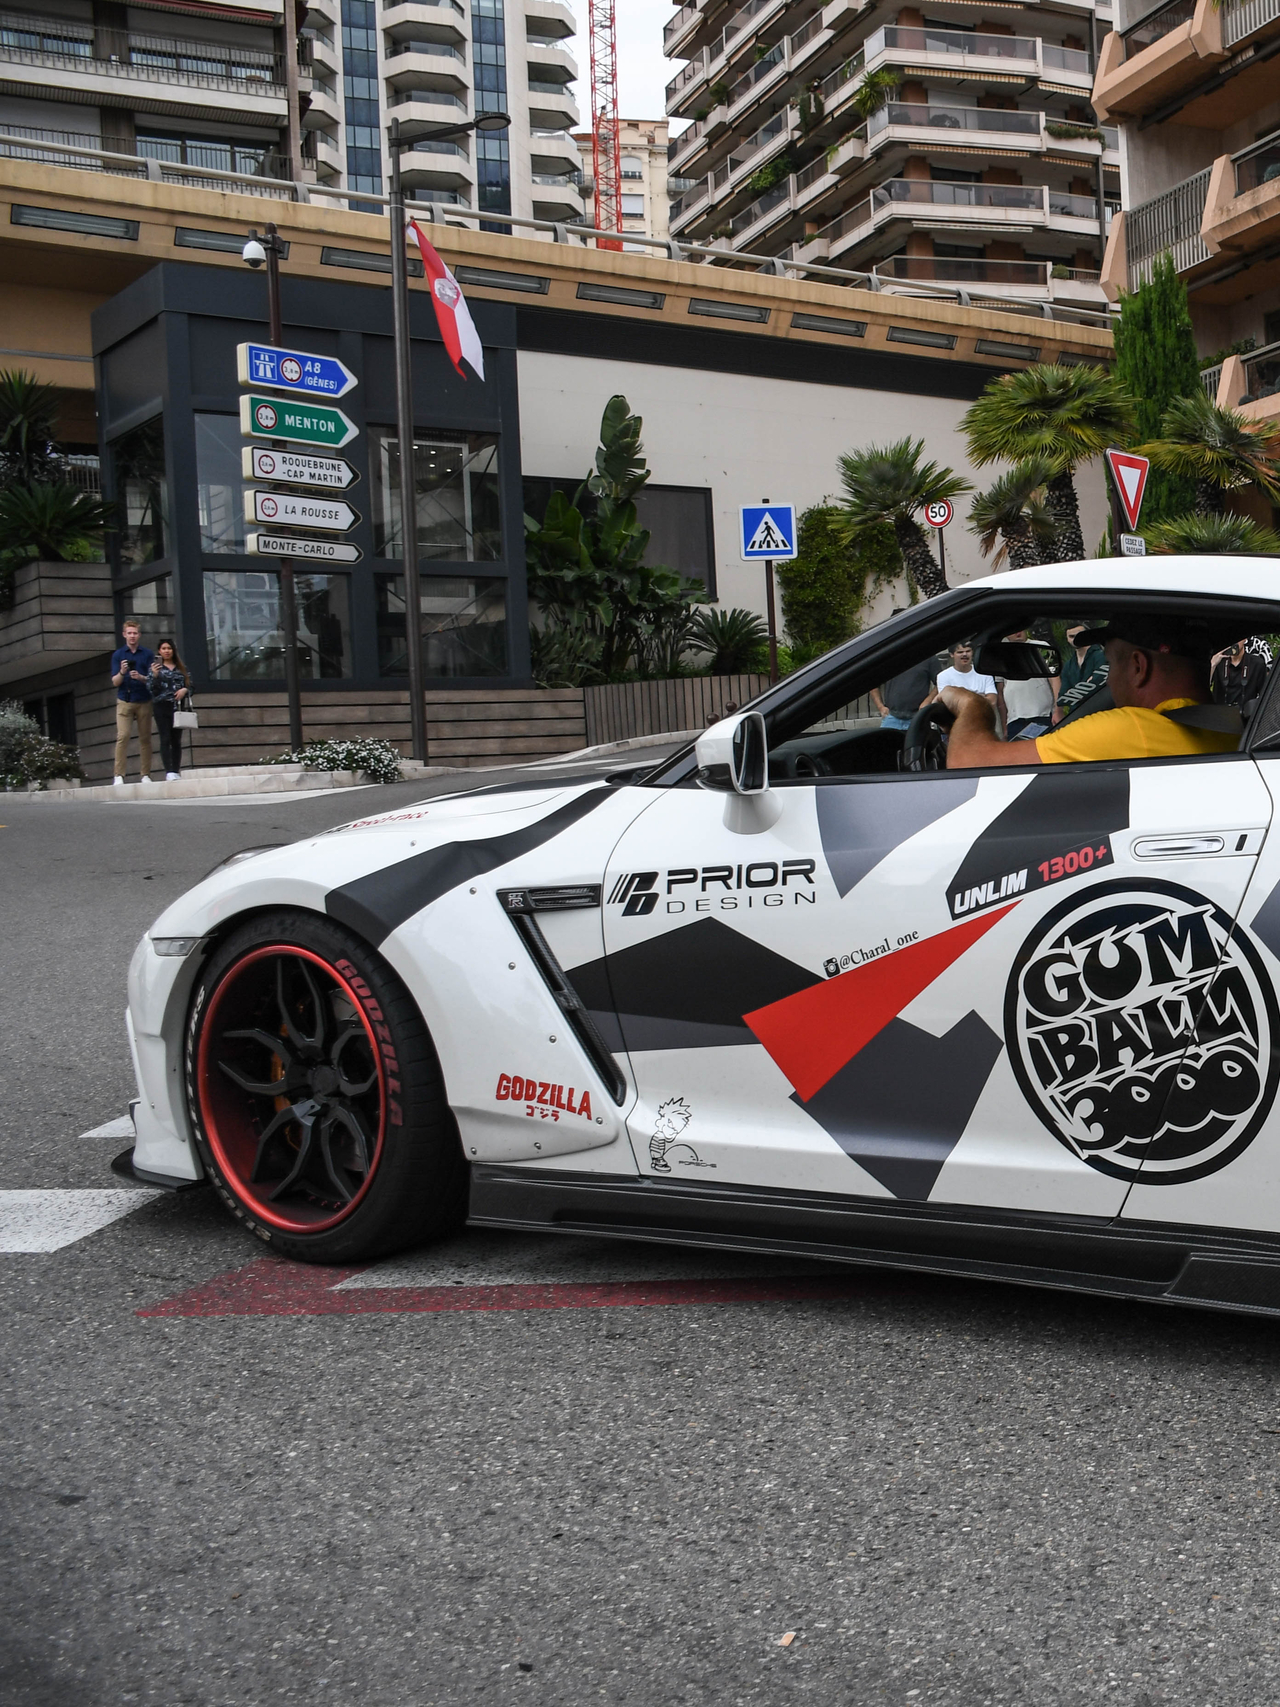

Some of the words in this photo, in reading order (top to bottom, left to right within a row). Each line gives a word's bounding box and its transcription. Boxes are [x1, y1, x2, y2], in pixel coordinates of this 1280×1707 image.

[304, 360, 321, 374] A8
[304, 375, 338, 390] (GÊNES)
[284, 413, 336, 433] MENTON
[281, 456, 343, 473] ROQUEBRUNE
[309, 471, 343, 485] MARTIN
[284, 504, 297, 515] LA
[301, 506, 340, 520] ROUSSE
[930, 505, 947, 519] 50
[262, 539, 335, 556] MONTE-CARLO
[666, 858, 816, 895] PRIOR
[953, 868, 1028, 915] UNLIM
[1037, 844, 1108, 882] 1300+
[666, 891, 816, 914] DESIGN
[839, 930, 920, 970] @Charal_one
[1022, 909, 1234, 1018] GUM
[1027, 965, 1259, 1086] BALL
[495, 1073, 592, 1121] GODZILLA
[1057, 1047, 1262, 1152] 3000
[526, 1104, 560, 1122] ゴジラ
